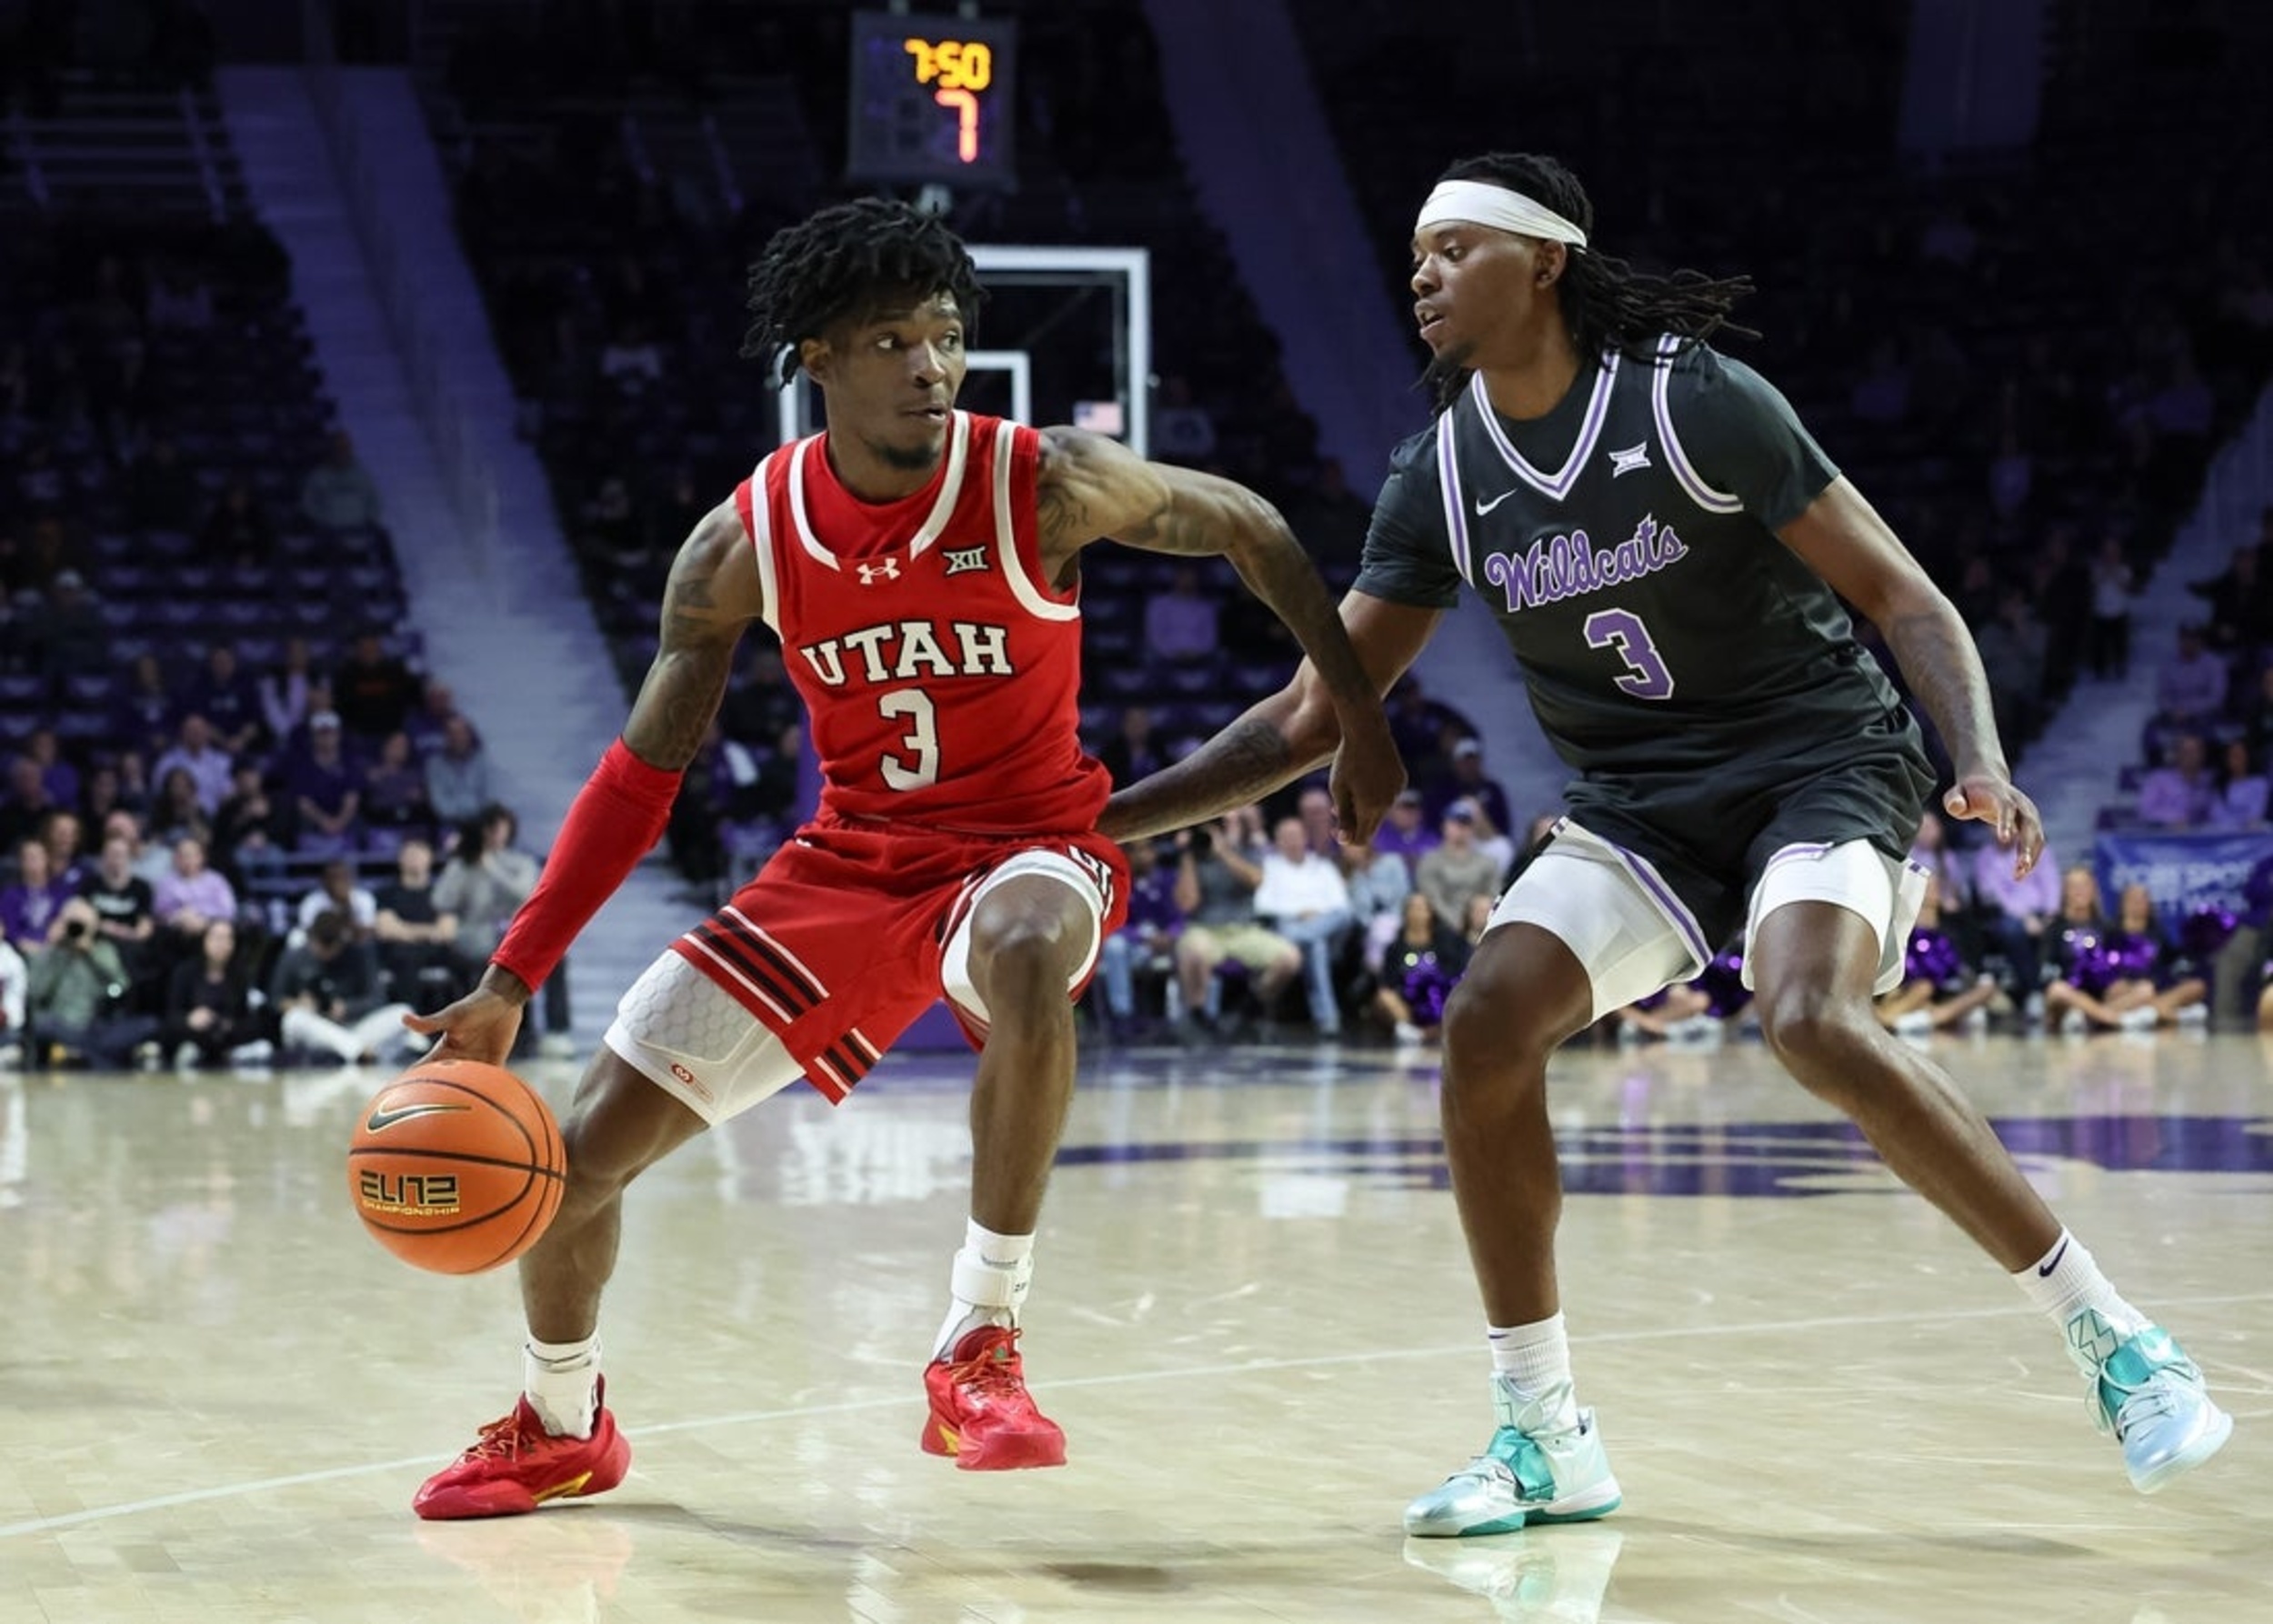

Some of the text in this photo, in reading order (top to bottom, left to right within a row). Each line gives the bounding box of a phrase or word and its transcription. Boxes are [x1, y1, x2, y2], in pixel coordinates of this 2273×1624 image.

[905, 38, 991, 91] 7:50
[935, 88, 978, 163] 7
[943, 546, 989, 576] XII
[1485, 512, 1689, 614] Wildcats
[799, 620, 1015, 687] UTAH
[1583, 607, 1675, 700] 3
[878, 687, 939, 793] 3
[360, 1168, 460, 1207] ELITE
